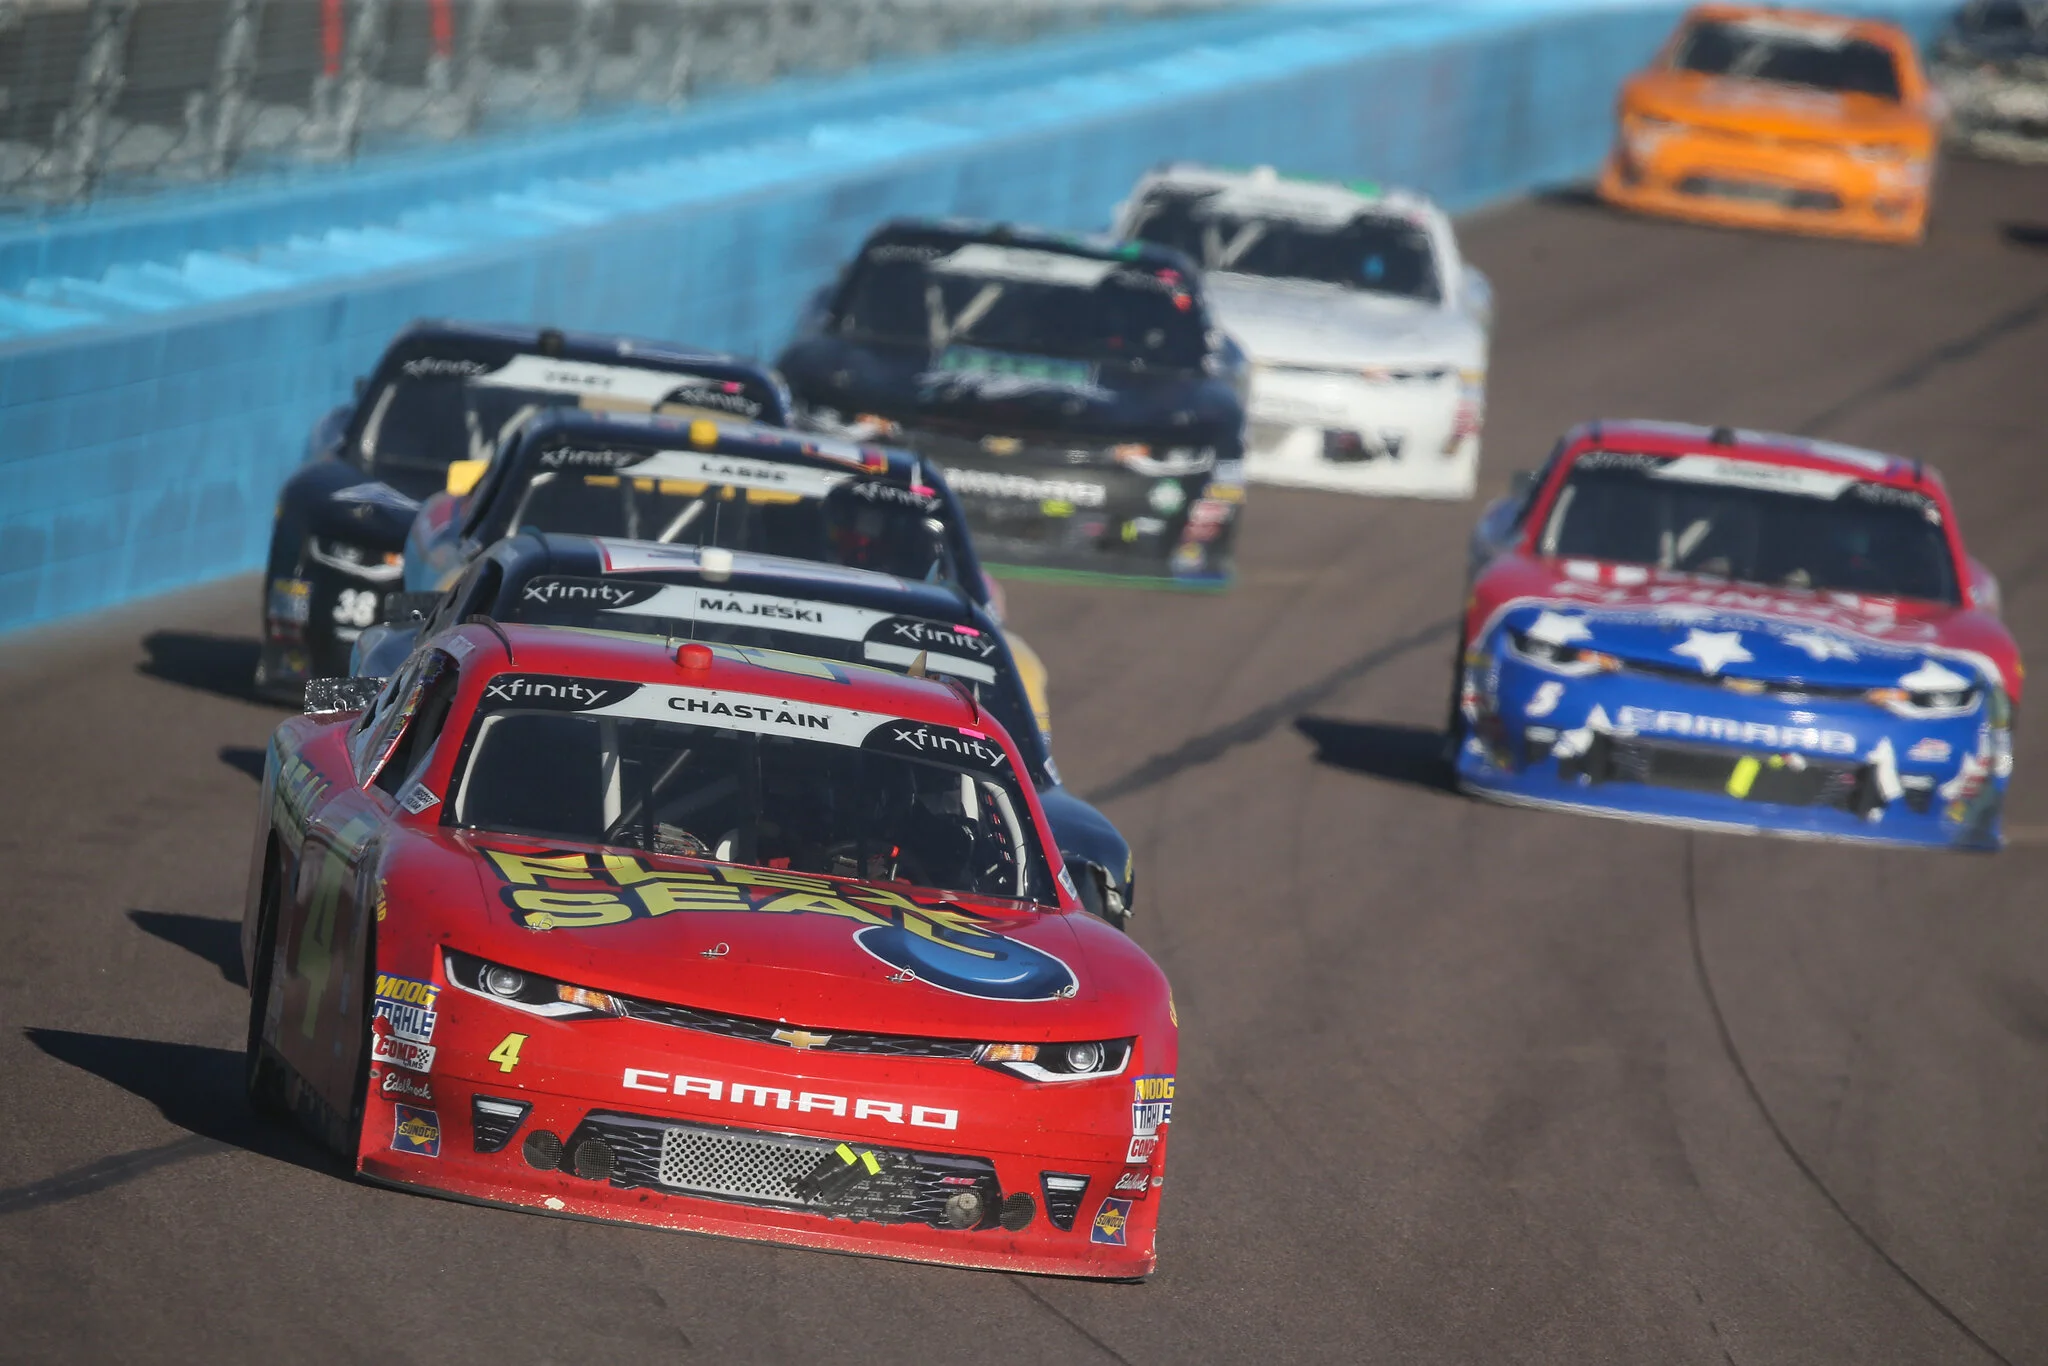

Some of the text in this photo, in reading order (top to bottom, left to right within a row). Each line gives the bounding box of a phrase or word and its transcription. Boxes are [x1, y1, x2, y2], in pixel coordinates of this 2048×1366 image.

[524, 581, 635, 604] xfinity
[700, 599, 823, 623] MAJESKI
[892, 621, 996, 657] xfinity
[486, 679, 608, 706] xfinity
[668, 696, 830, 730] CHASTAIN
[893, 728, 1006, 767] xfinity
[511, 881, 997, 960] SEAL
[375, 974, 441, 1006] MOOG
[374, 1036, 418, 1061] COMP
[488, 1031, 530, 1074] 4
[382, 1072, 432, 1100] Edelbrock
[622, 1067, 959, 1131] CAMARO
[1134, 1078, 1175, 1102] MOOG
[400, 1122, 438, 1139] SUNOCO
